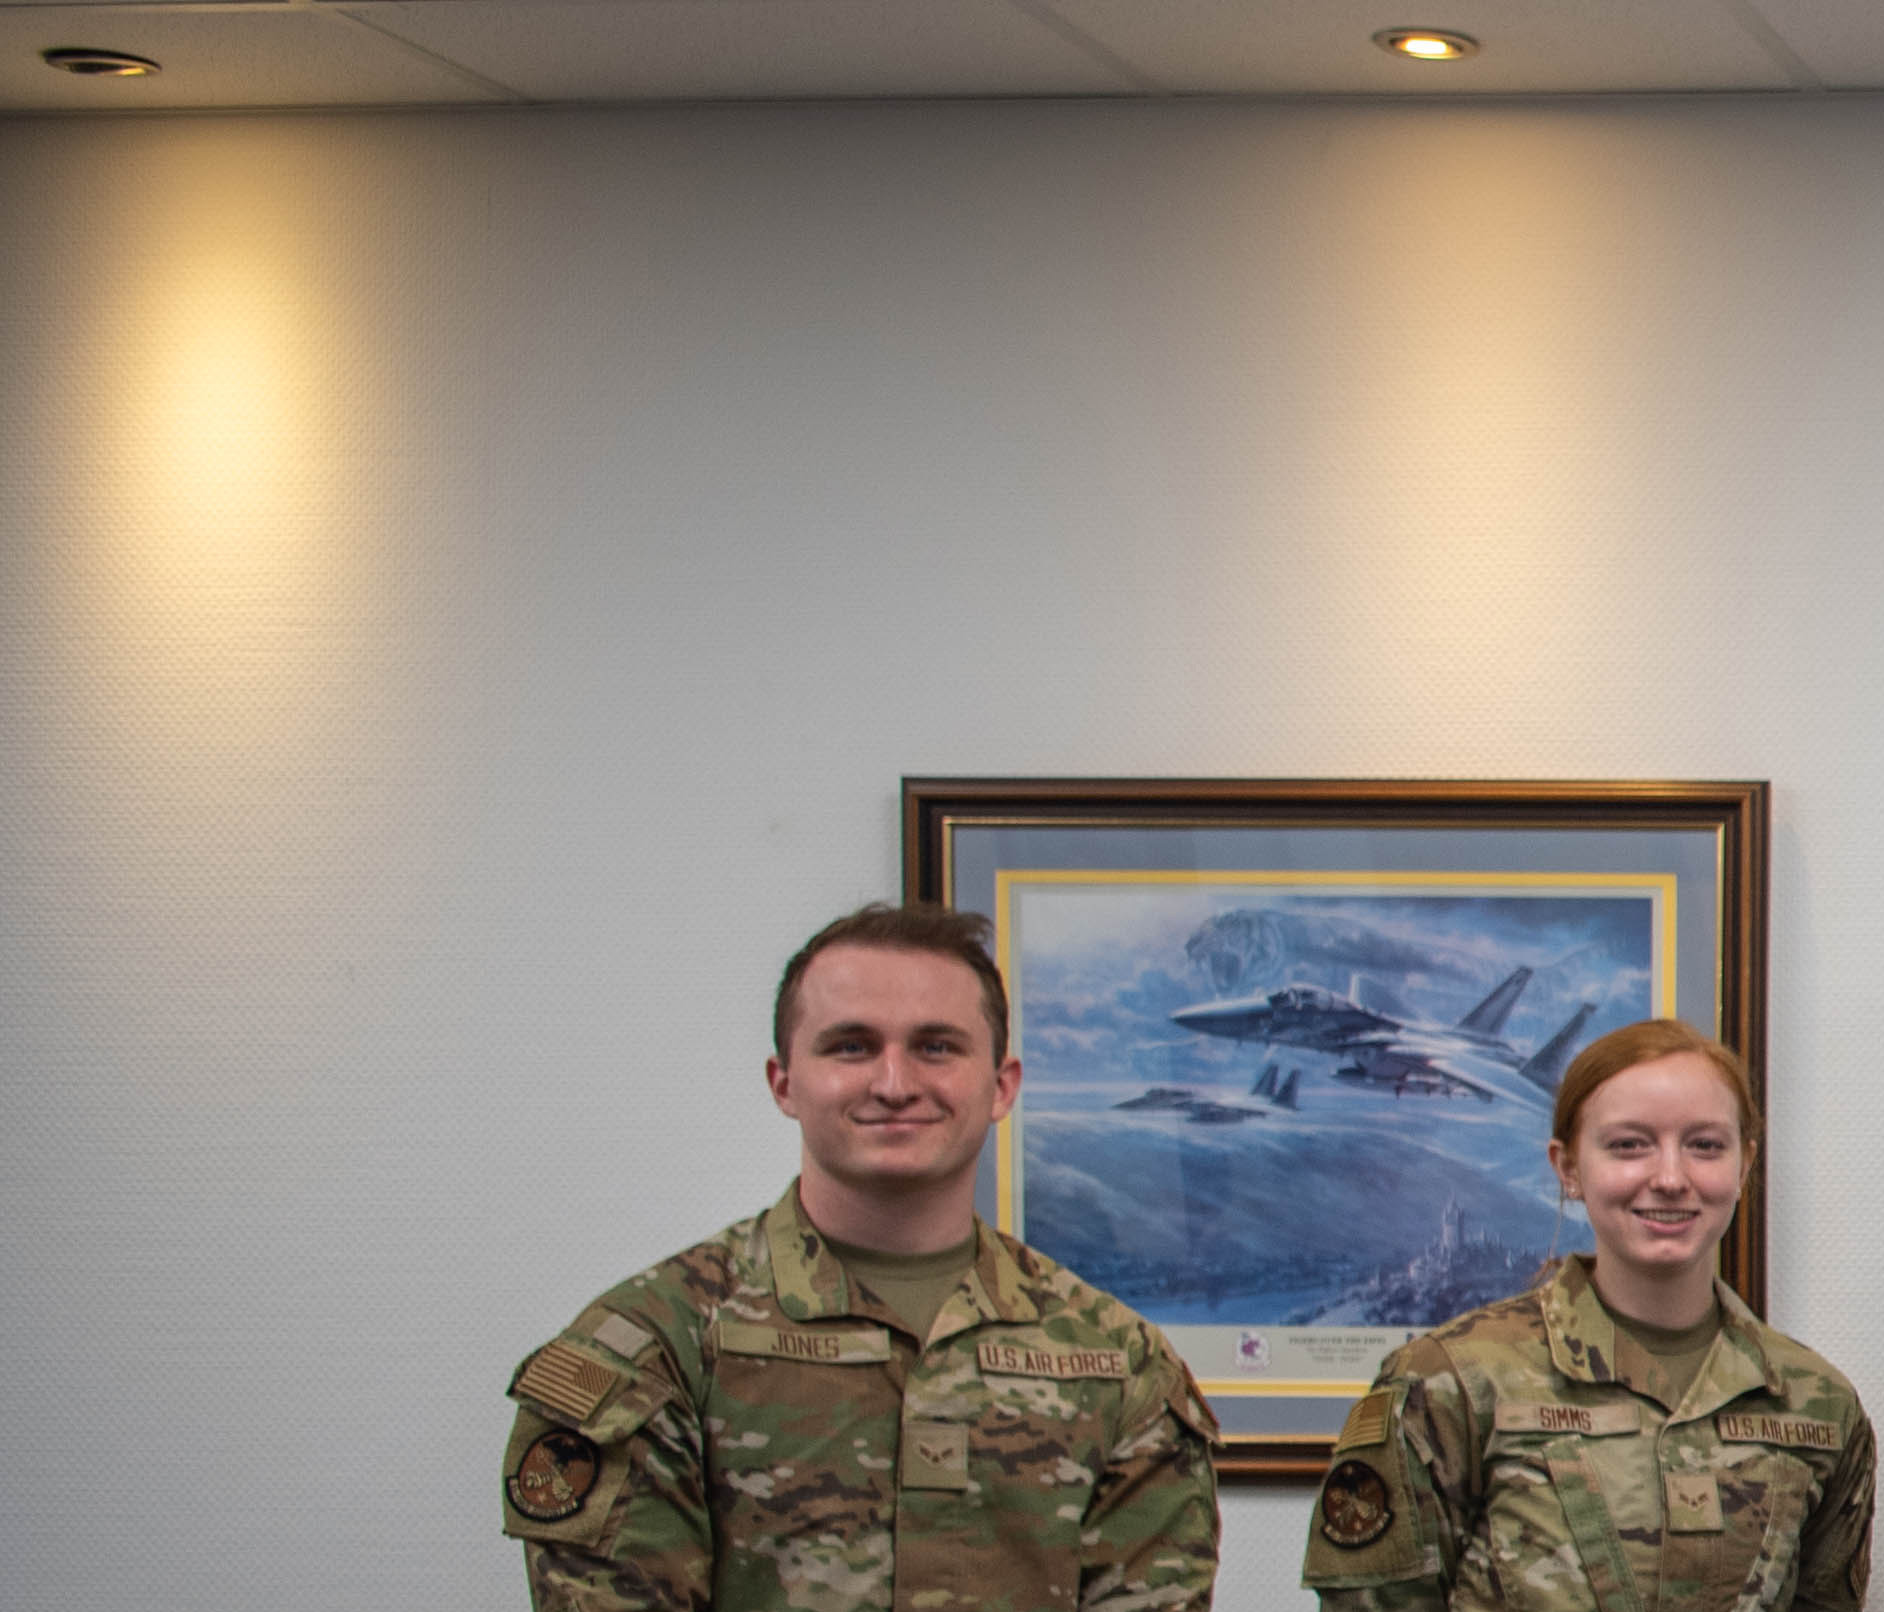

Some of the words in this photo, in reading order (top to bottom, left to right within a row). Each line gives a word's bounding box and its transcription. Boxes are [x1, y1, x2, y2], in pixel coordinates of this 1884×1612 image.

[771, 1332, 840, 1358] JONES
[1025, 1352, 1054, 1374] AIR
[1056, 1352, 1122, 1376] FORCE
[1540, 1407, 1592, 1432] SIMMS
[1761, 1418, 1784, 1442] AIR
[1784, 1421, 1835, 1446] FORCE
